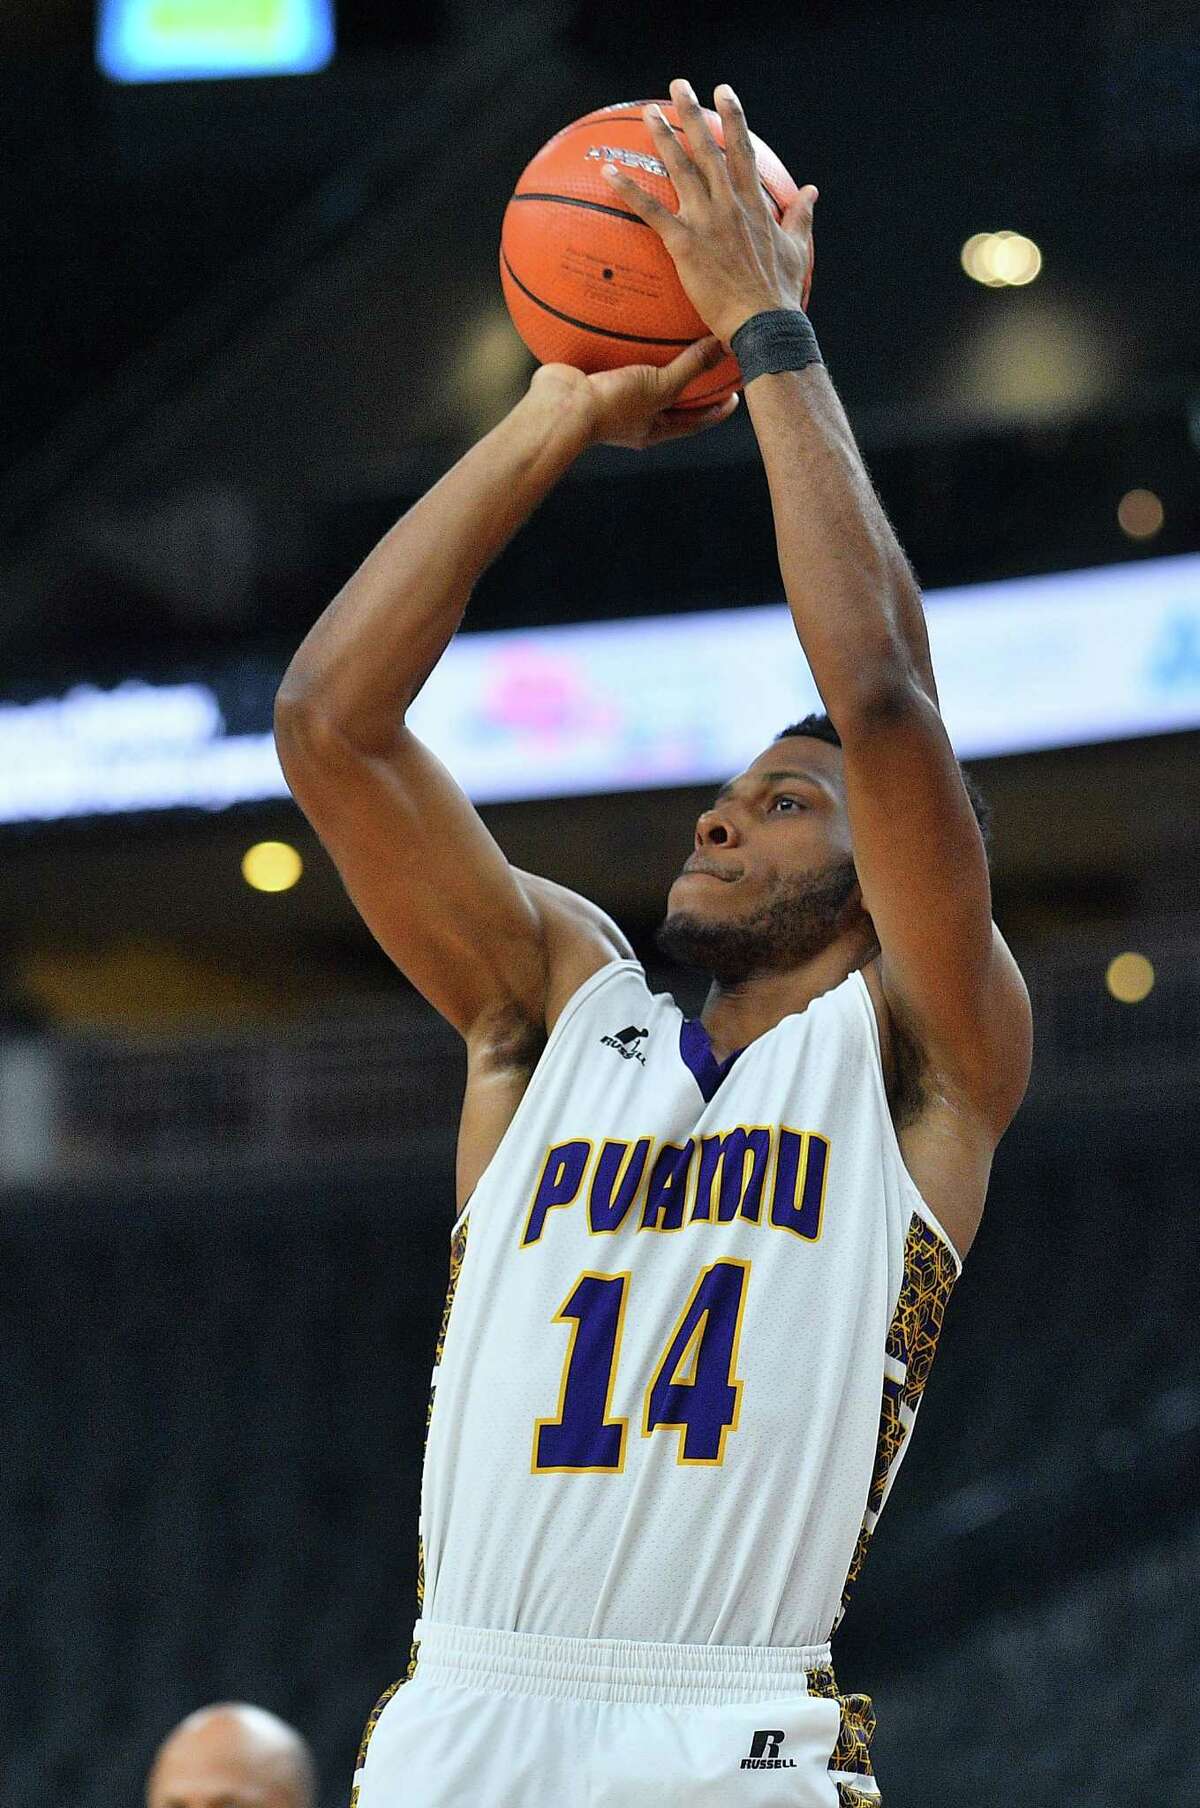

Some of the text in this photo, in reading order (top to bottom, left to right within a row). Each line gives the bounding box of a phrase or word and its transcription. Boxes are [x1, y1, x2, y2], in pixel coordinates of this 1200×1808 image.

[519, 1123, 832, 1249] PVAMU
[530, 1256, 752, 1475] 14
[740, 1759, 798, 1769] RUSSELL
[749, 1730, 786, 1758] R
